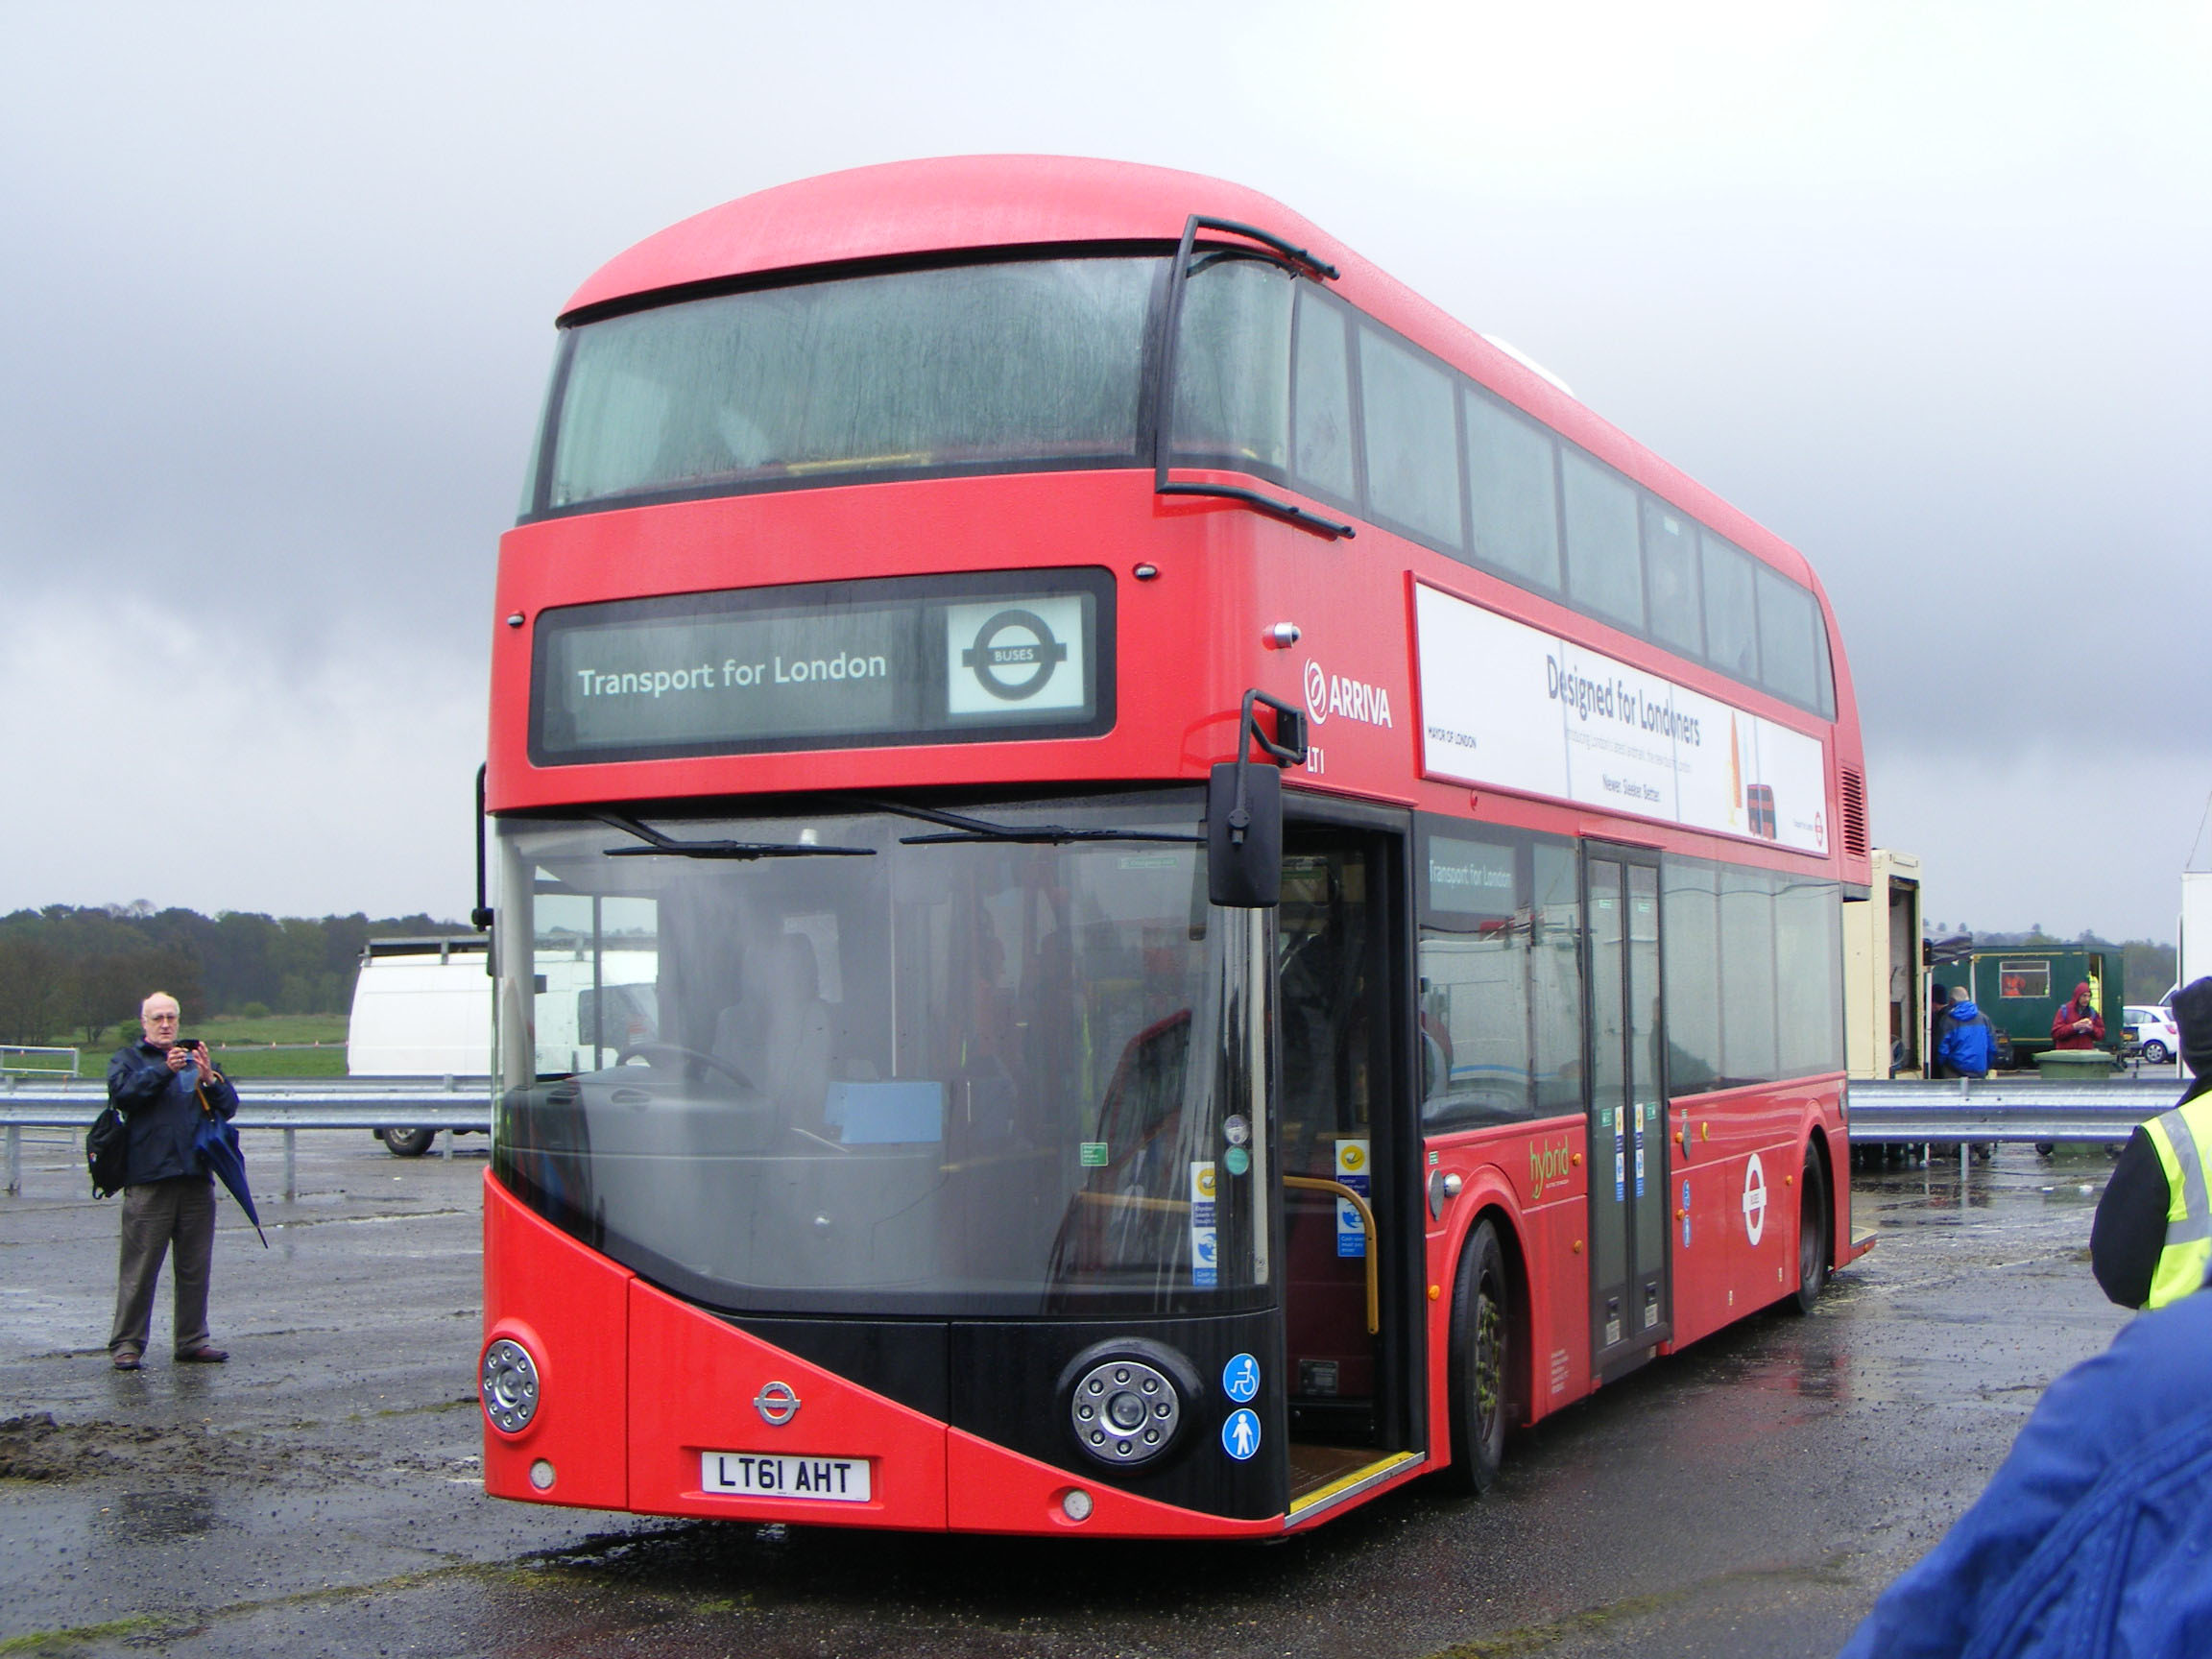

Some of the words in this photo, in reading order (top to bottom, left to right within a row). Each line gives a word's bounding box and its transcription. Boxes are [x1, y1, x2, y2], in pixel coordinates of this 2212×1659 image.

[578, 663, 715, 698] Transport
[723, 659, 765, 686] for
[774, 652, 886, 684] London
[995, 649, 1034, 661] BUSES
[1329, 675, 1393, 729] ARRIVA
[1547, 654, 1614, 721] Designed
[1618, 680, 1635, 726] for
[1639, 688, 1700, 747] Londoners
[1429, 728, 1445, 741] MAYOR
[1455, 733, 1476, 749] LONDON
[1430, 859, 1469, 889] Transport
[1529, 1135, 1569, 1199] hybrid
[719, 1456, 783, 1489] LT61
[796, 1461, 852, 1493] AHT
